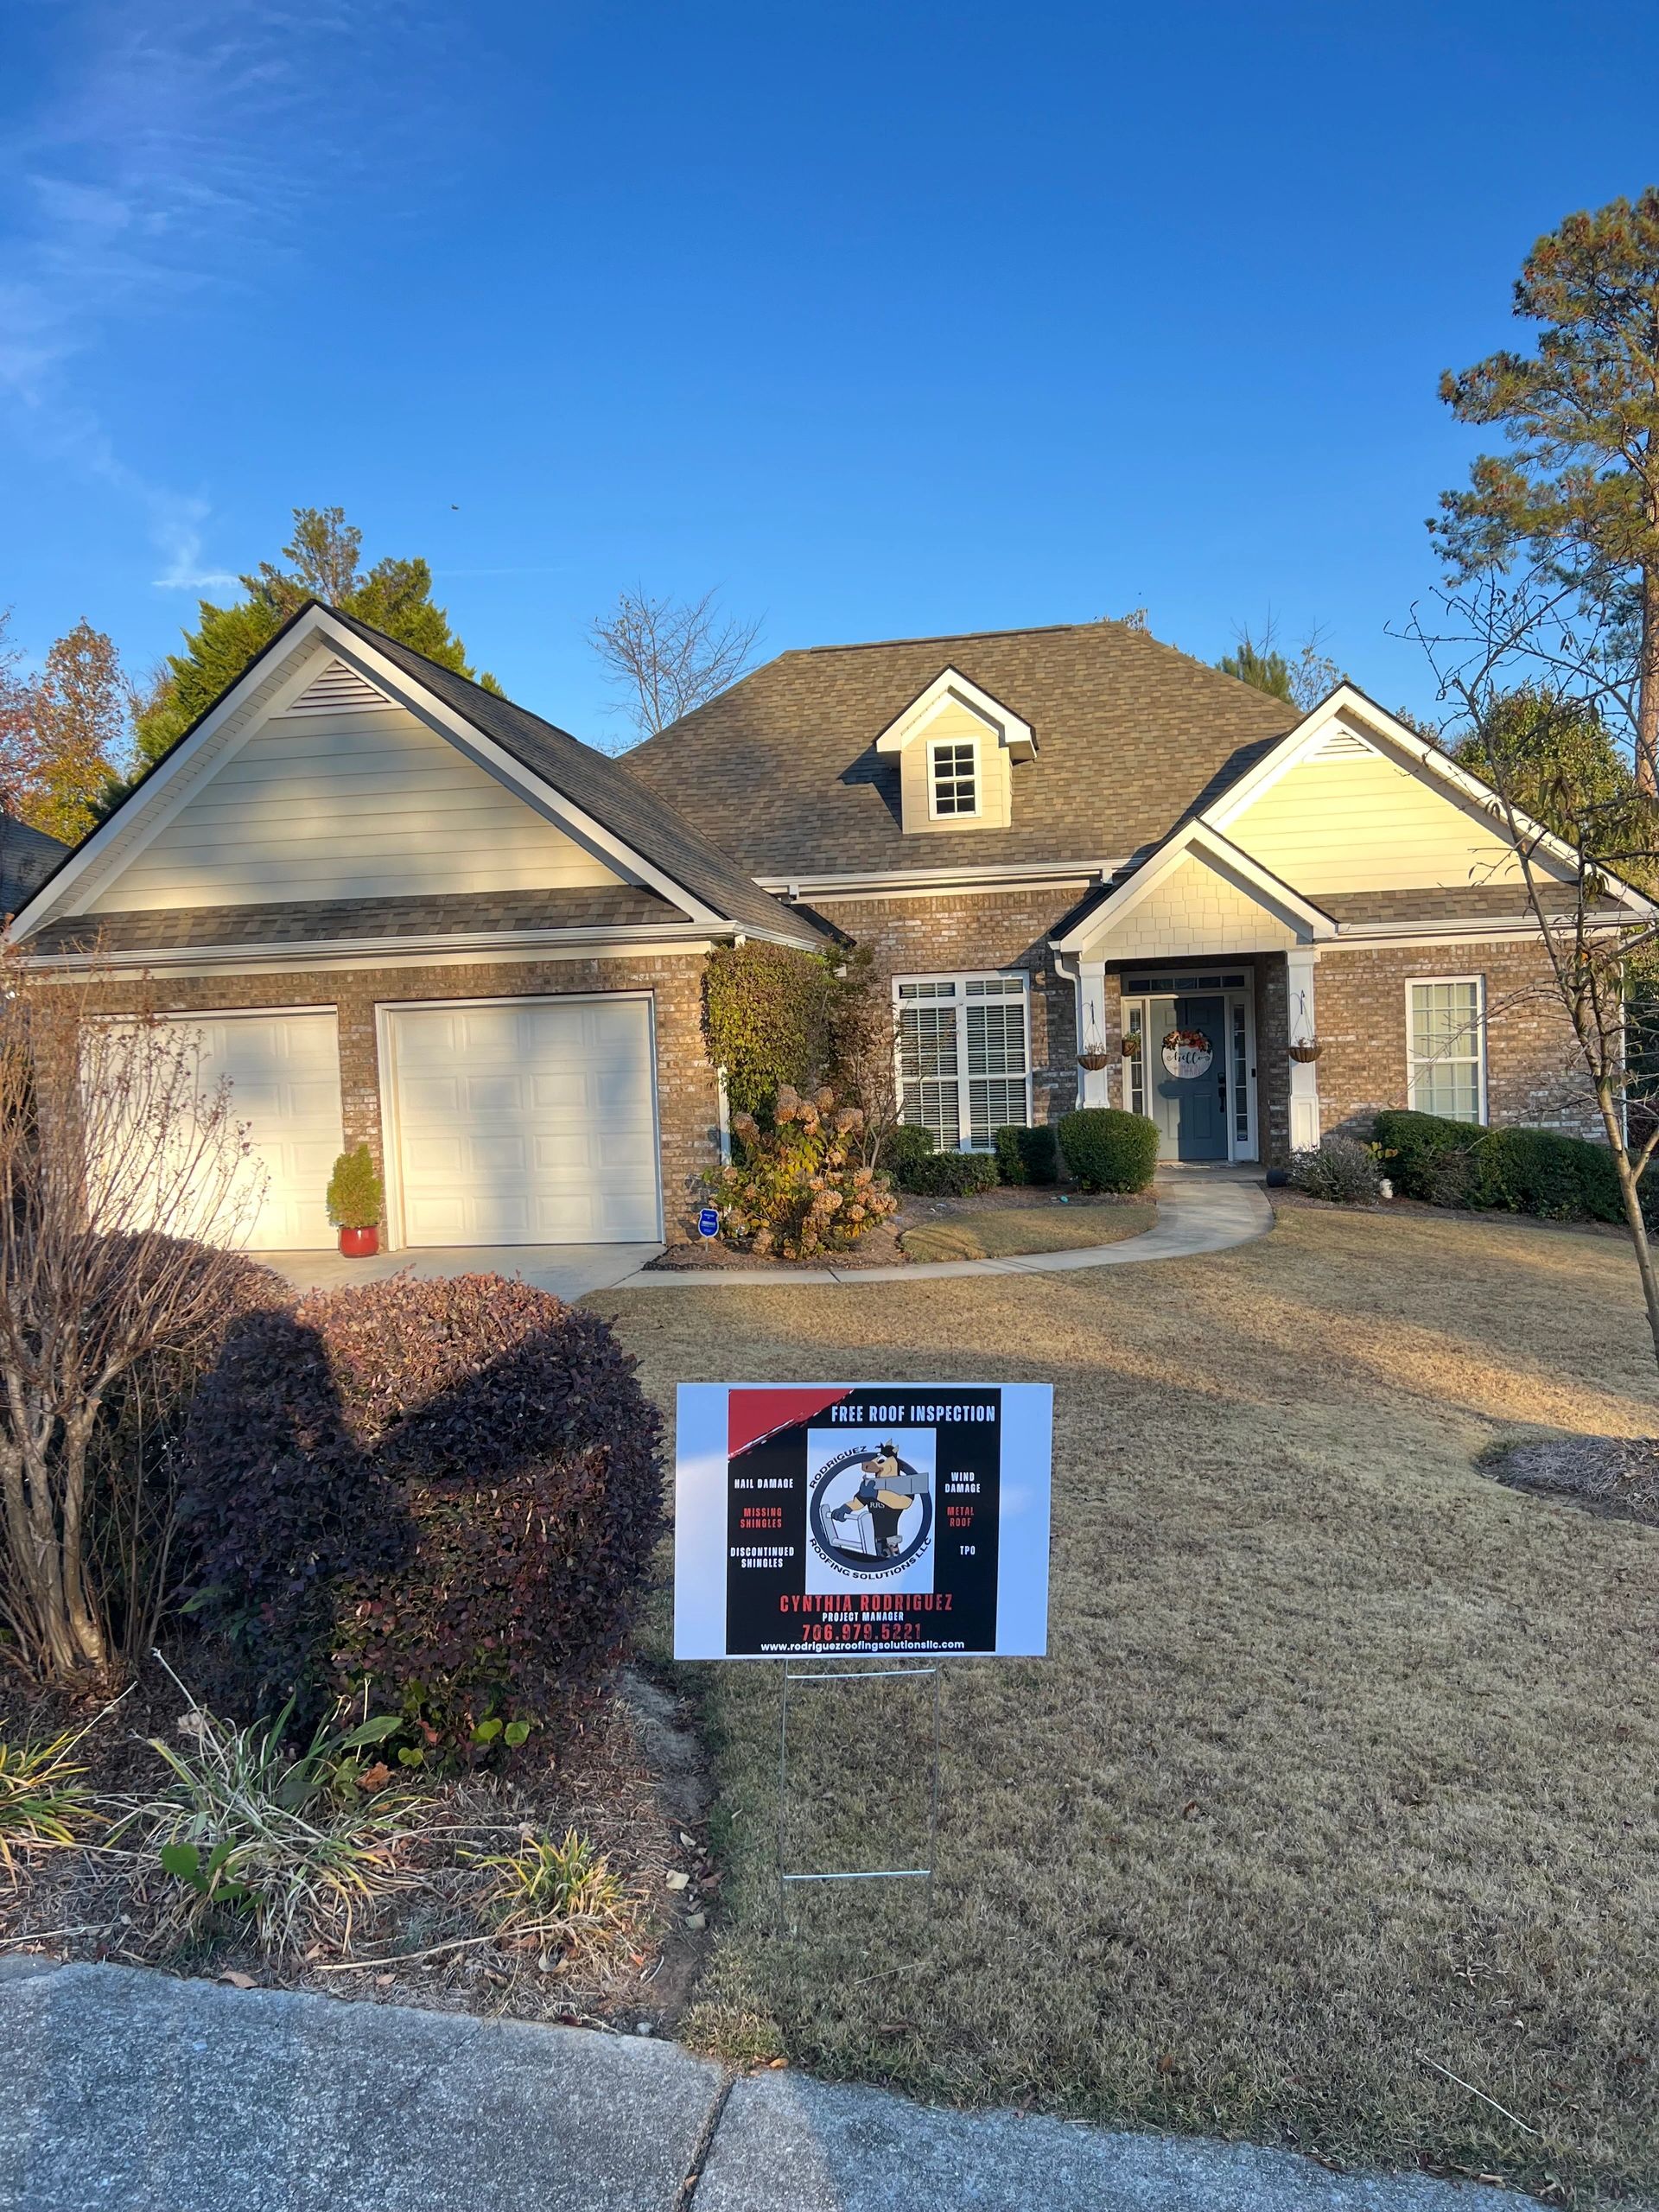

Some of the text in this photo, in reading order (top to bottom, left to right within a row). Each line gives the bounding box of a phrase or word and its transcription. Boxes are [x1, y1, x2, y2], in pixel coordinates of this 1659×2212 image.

[831, 1405, 995, 1422] FREE ROOF INSPECTION
[809, 1446, 868, 1489] RODRIGUEZ
[950, 1471, 975, 1482] WIND
[734, 1478, 794, 1489] HAIL DAMAGE
[944, 1483, 981, 1493] DAMAGE
[743, 1507, 782, 1517] MISSING
[946, 1506, 975, 1516] METAL
[740, 1518, 782, 1529] SHINGLES
[949, 1517, 972, 1528] ROOF
[730, 1546, 795, 1557] DISCONTINUED
[959, 1545, 976, 1555] TPO
[741, 1558, 784, 1568] SHINGLES
[809, 1537, 931, 1580] ROOFING SOLUTIONS LLC
[779, 1593, 953, 1612] CYNTHIA RODRIGUEZ
[822, 1611, 904, 1622] PROJECT MANAGER
[802, 1623, 921, 1642] 706.979.5221
[760, 1640, 965, 1653] www.rodriguezroofingsolutionsllc.com
